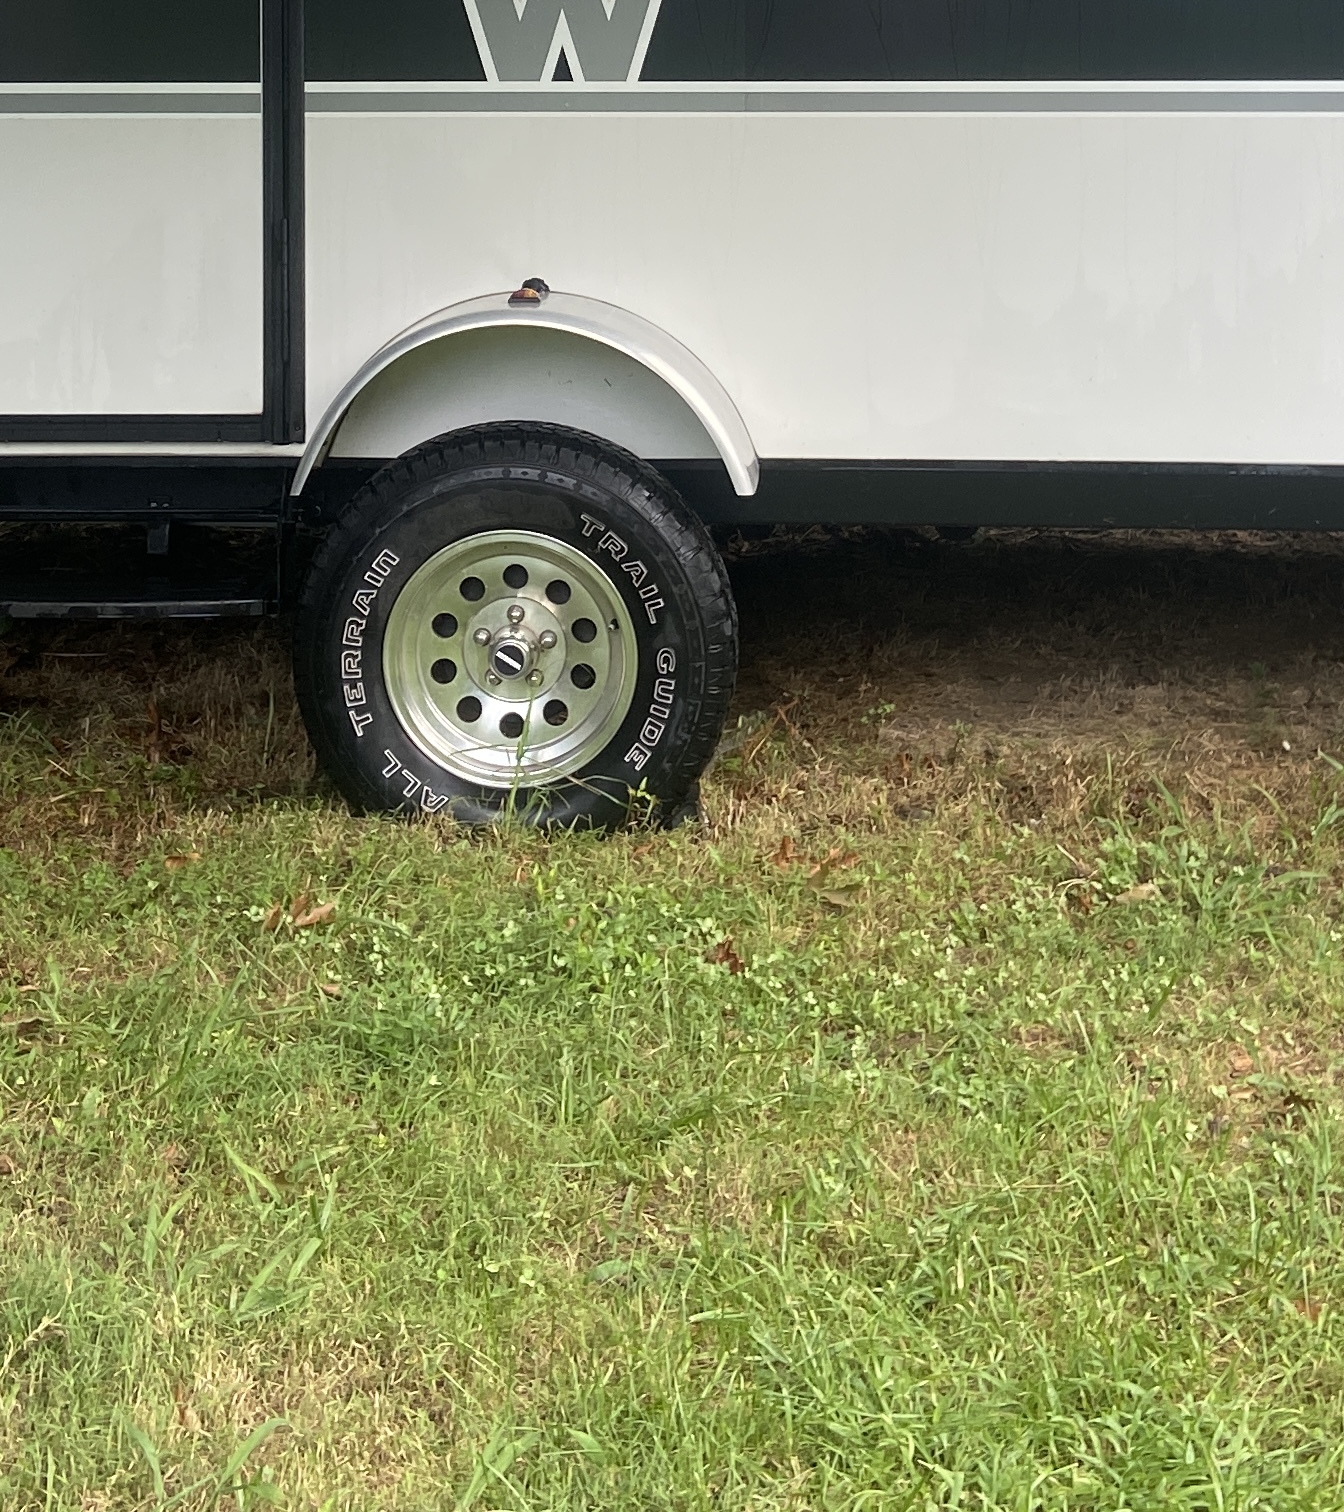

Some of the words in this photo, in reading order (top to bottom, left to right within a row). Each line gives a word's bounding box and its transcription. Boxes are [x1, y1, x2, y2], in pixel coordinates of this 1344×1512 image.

[579, 513, 668, 625] TRAIL
[341, 548, 400, 737] TERRAIN
[623, 648, 677, 772] GUIDE
[381, 748, 450, 814] ALL
